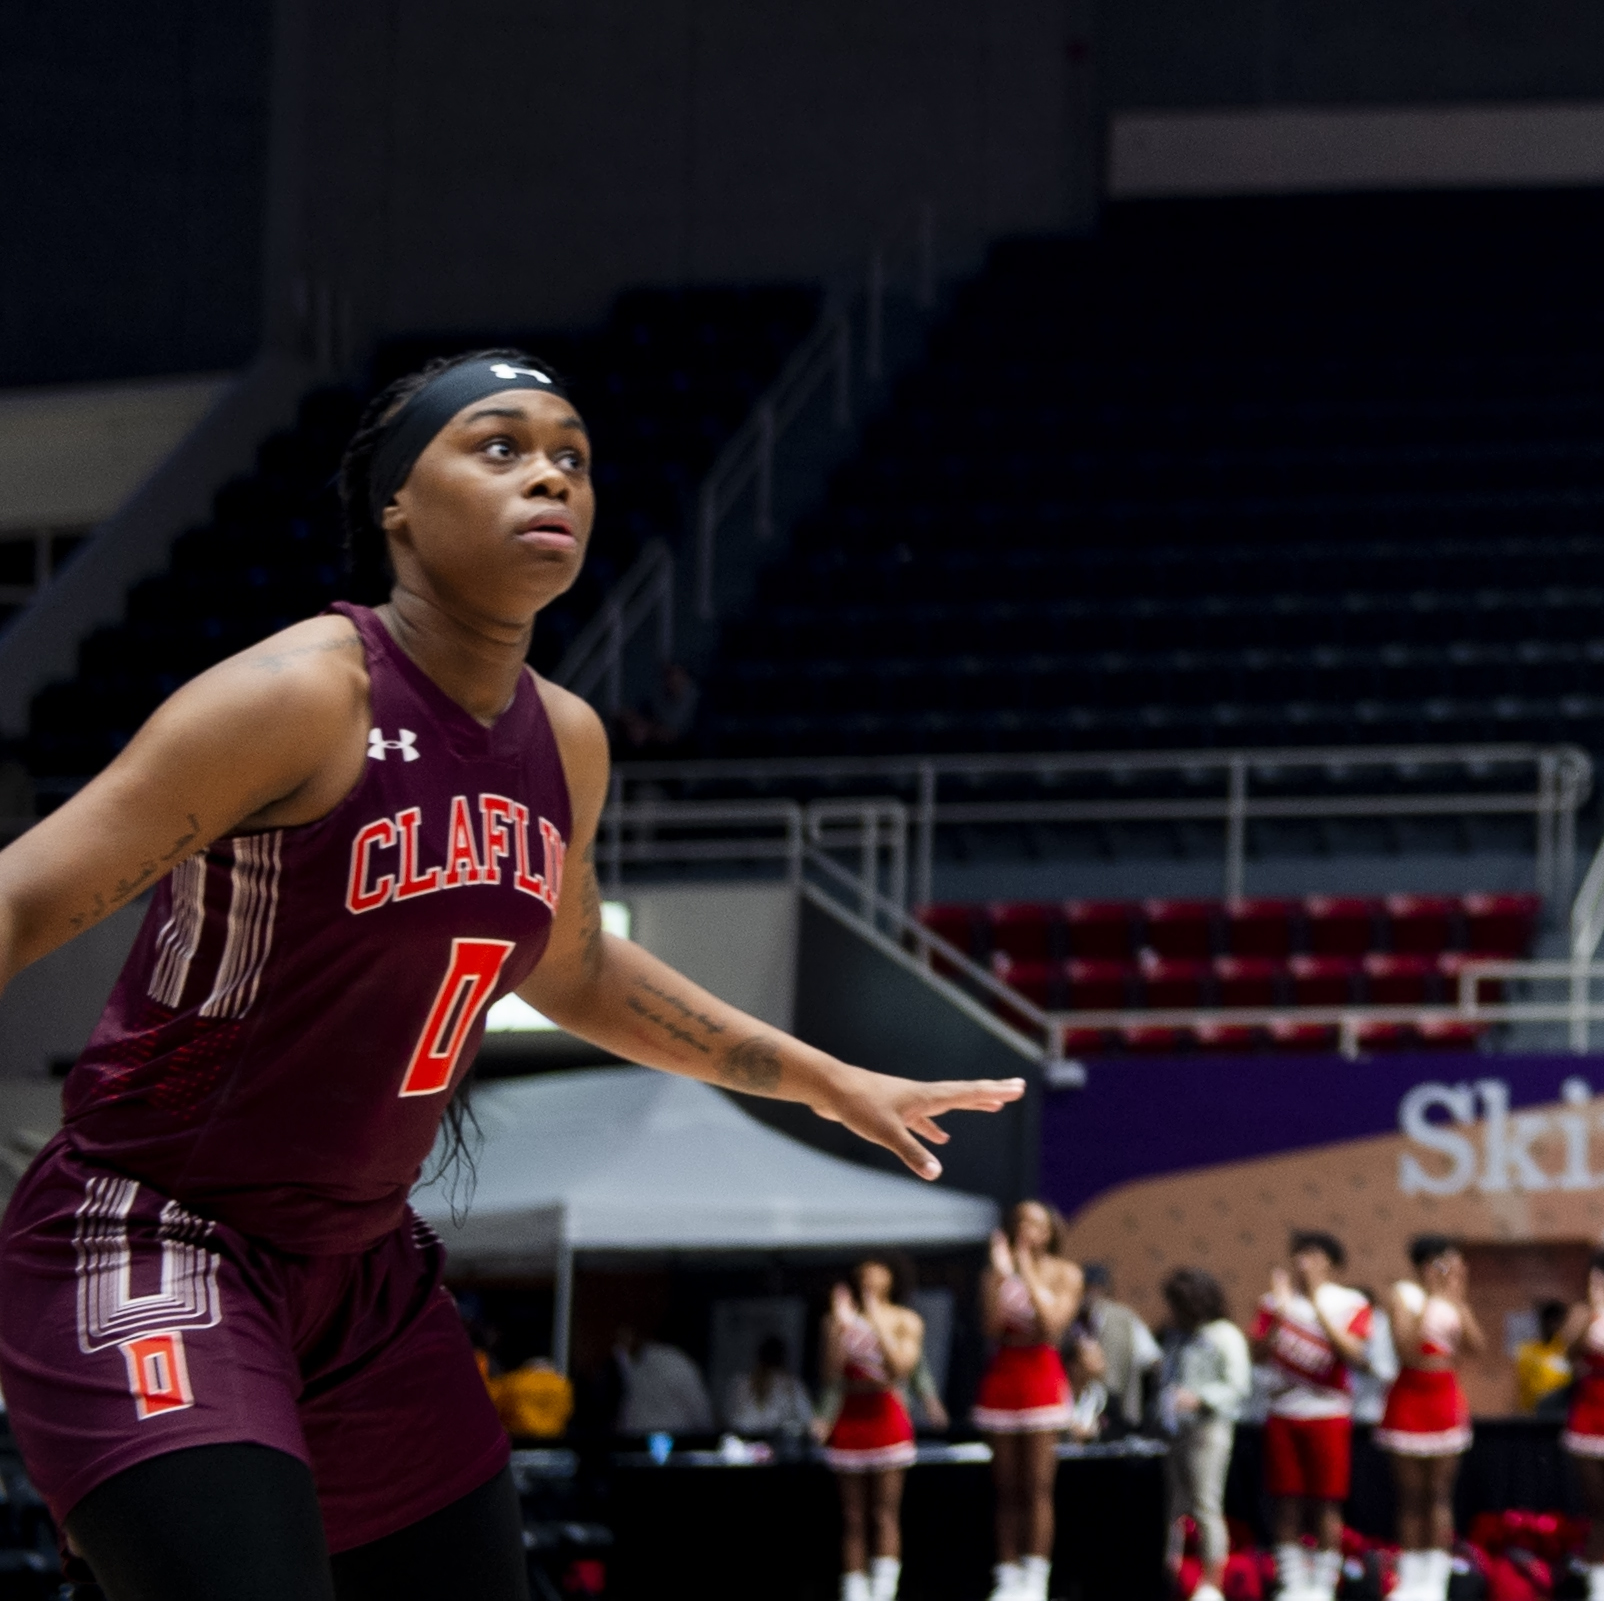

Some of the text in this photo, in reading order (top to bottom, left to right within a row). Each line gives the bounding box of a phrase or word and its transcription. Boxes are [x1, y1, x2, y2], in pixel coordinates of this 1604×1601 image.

[345, 793, 567, 917] CLAFLI
[398, 936, 516, 1098] 0
[117, 1329, 195, 1421] 0
